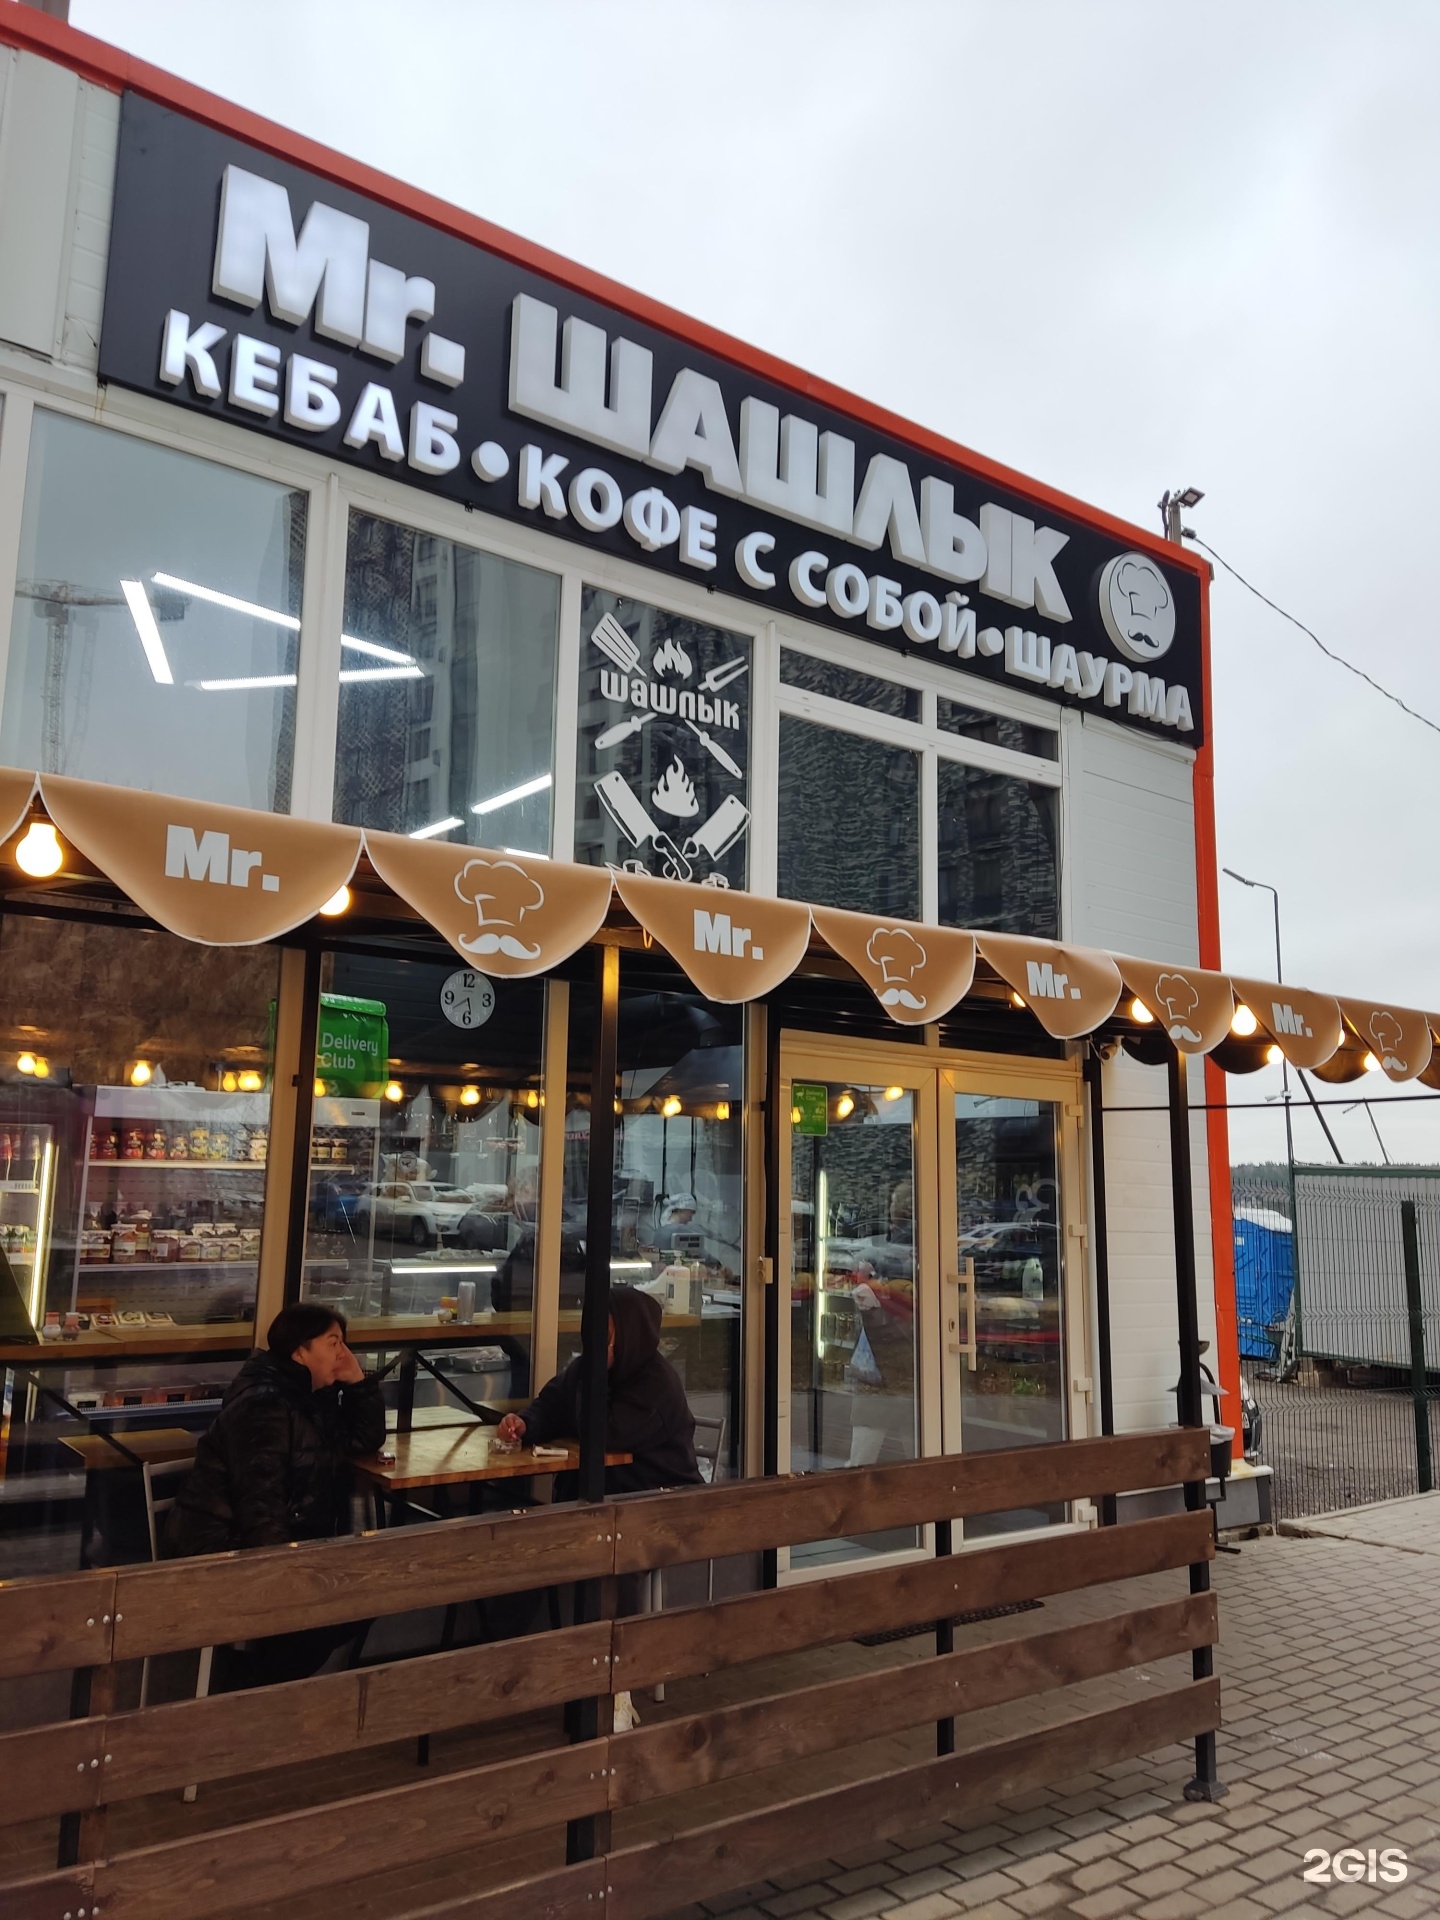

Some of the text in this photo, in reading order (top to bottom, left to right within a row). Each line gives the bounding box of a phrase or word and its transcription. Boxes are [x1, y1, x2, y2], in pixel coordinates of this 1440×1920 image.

[212, 163, 1072, 624] Mr. ШАШЛЫК
[159, 308, 1195, 732] КЕБАБ КОФЕ С СОБОЙ ШАУРМА
[164, 823, 280, 893] Mr.
[693, 908, 764, 961] Mr.
[463, 973, 475, 988] 12
[1026, 960, 1082, 1000] Mr.
[444, 990, 454, 1005] 9
[482, 993, 492, 1008] 3
[462, 1010, 472, 1026] 6
[1271, 1002, 1314, 1038] Mr.
[321, 1032, 379, 1056] Delivery
[320, 1052, 356, 1070] Club
